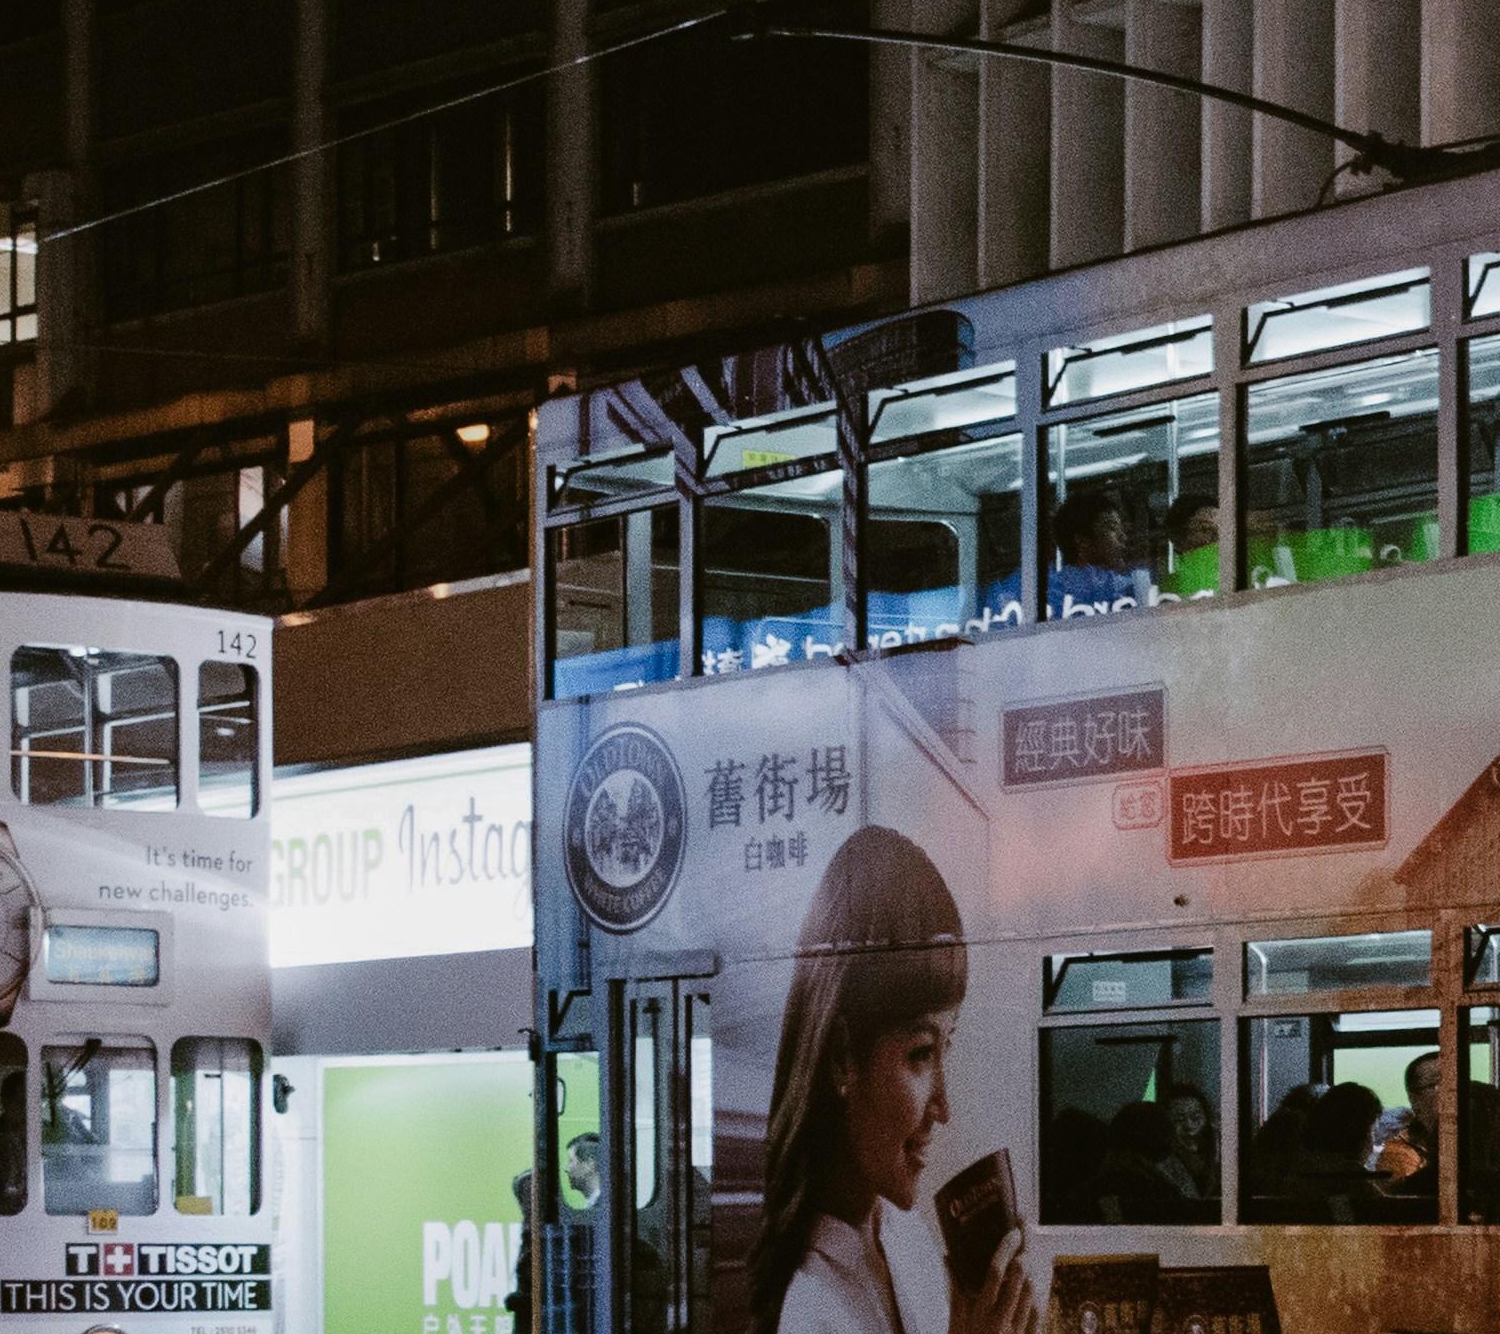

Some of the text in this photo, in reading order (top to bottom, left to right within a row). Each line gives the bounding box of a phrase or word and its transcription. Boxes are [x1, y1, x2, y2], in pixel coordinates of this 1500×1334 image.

[20, 517, 132, 571] 142
[217, 630, 258, 659] 142
[1015, 707, 1155, 770] 經典好味
[704, 744, 852, 830] 舊街場
[1182, 767, 1373, 846] 跨時代享受
[146, 845, 253, 873] It's time for
[271, 827, 384, 909] GROUP
[743, 835, 809, 872] 白咖啡
[99, 884, 141, 900] new
[140, 1245, 258, 1274] TISSOT
[424, 1220, 522, 1309] POA
[5, 1281, 258, 1311] THIS IS YOUR TIME
